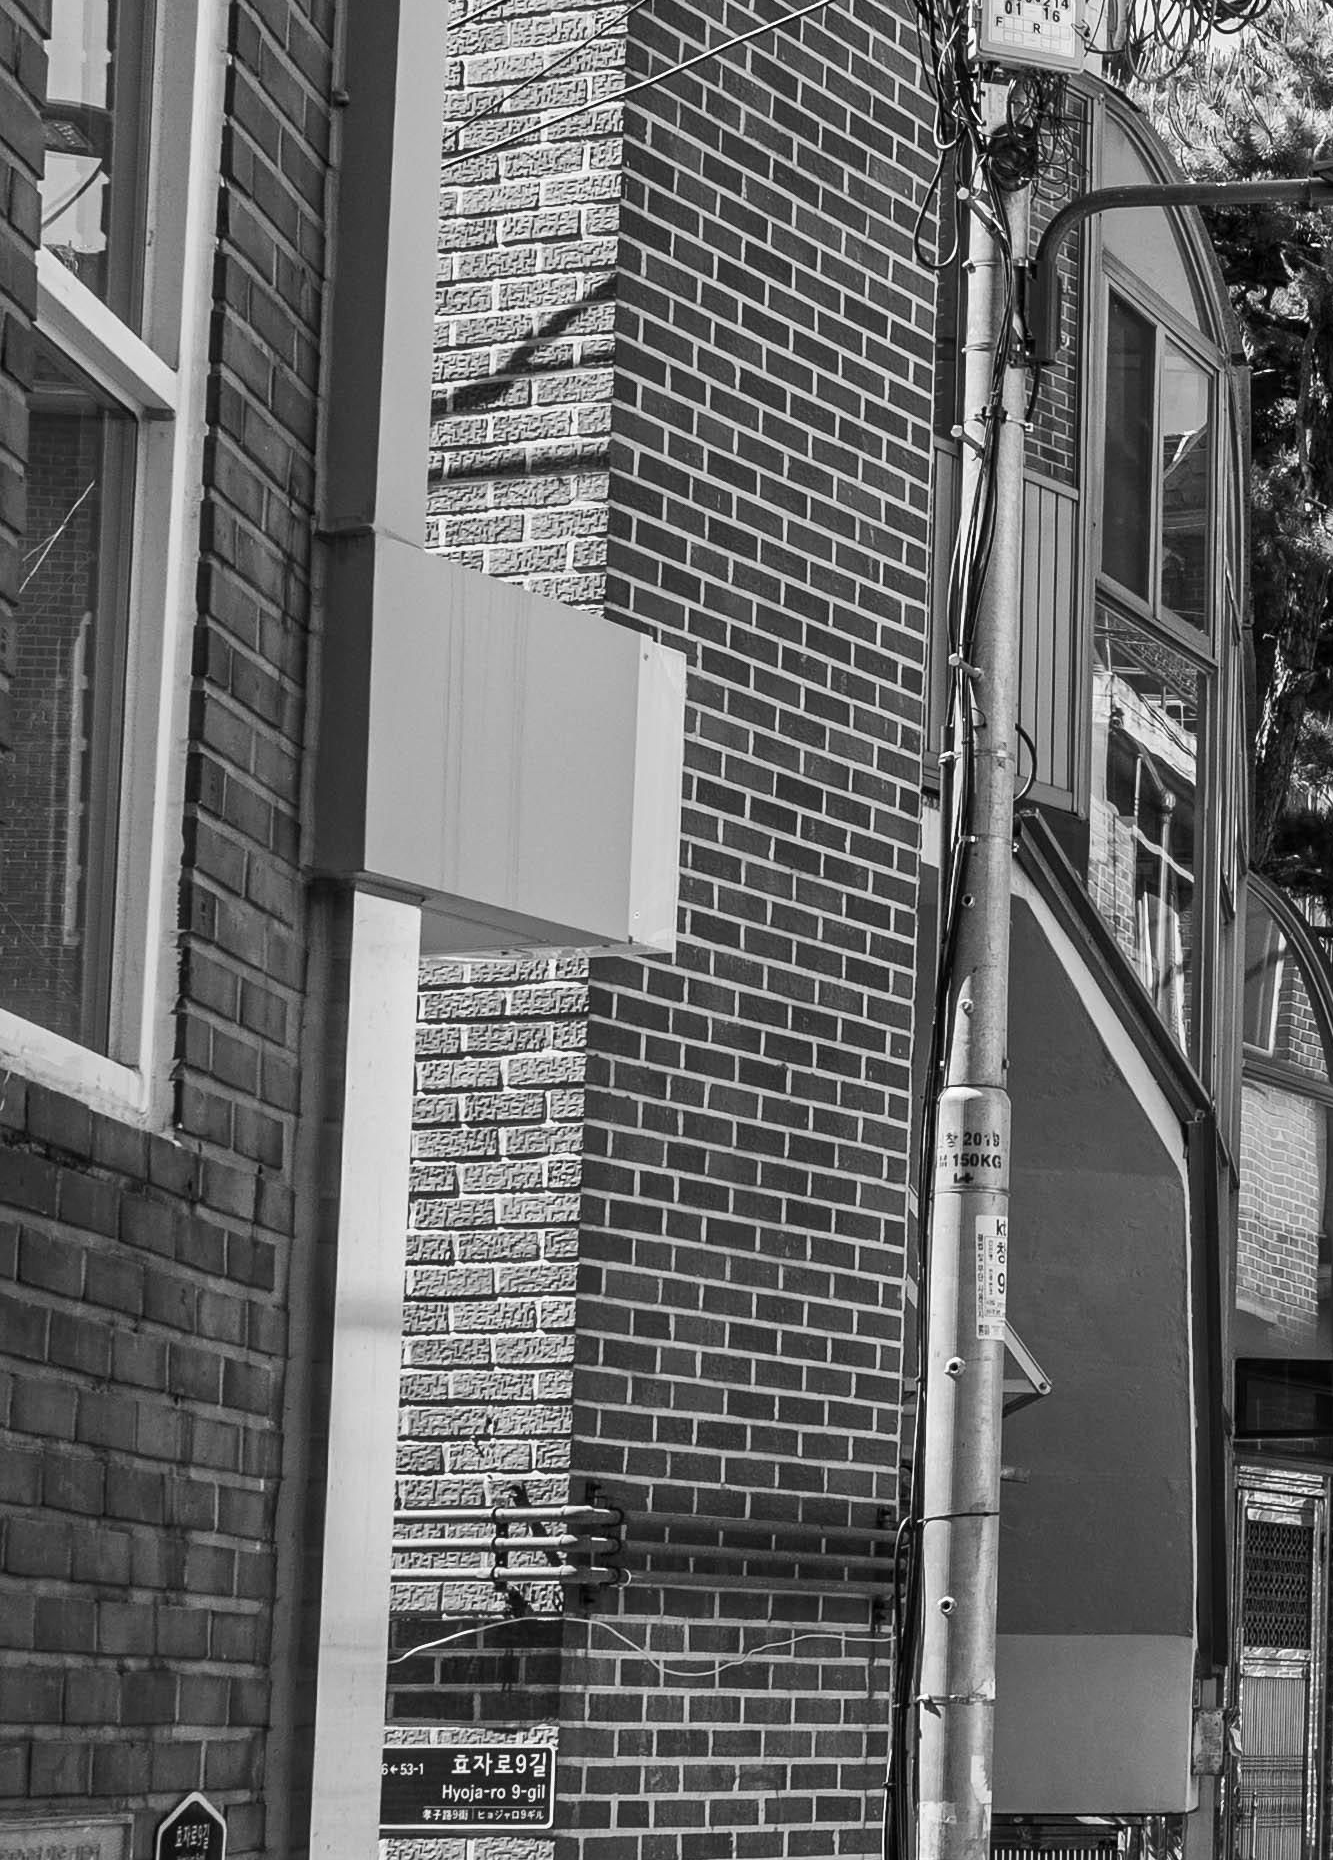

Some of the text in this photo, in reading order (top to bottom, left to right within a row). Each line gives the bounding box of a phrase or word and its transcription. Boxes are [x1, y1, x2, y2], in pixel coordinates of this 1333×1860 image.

[1043, 7, 1061, 22] 16
[953, 1153, 1002, 1169] 150KG
[400, 1763, 424, 1775] 53-1
[451, 1752, 547, 1777] 효자로9길
[442, 1784, 546, 1802] Hyoja-ro 9-gil
[175, 1823, 210, 1849] 효자로9길
